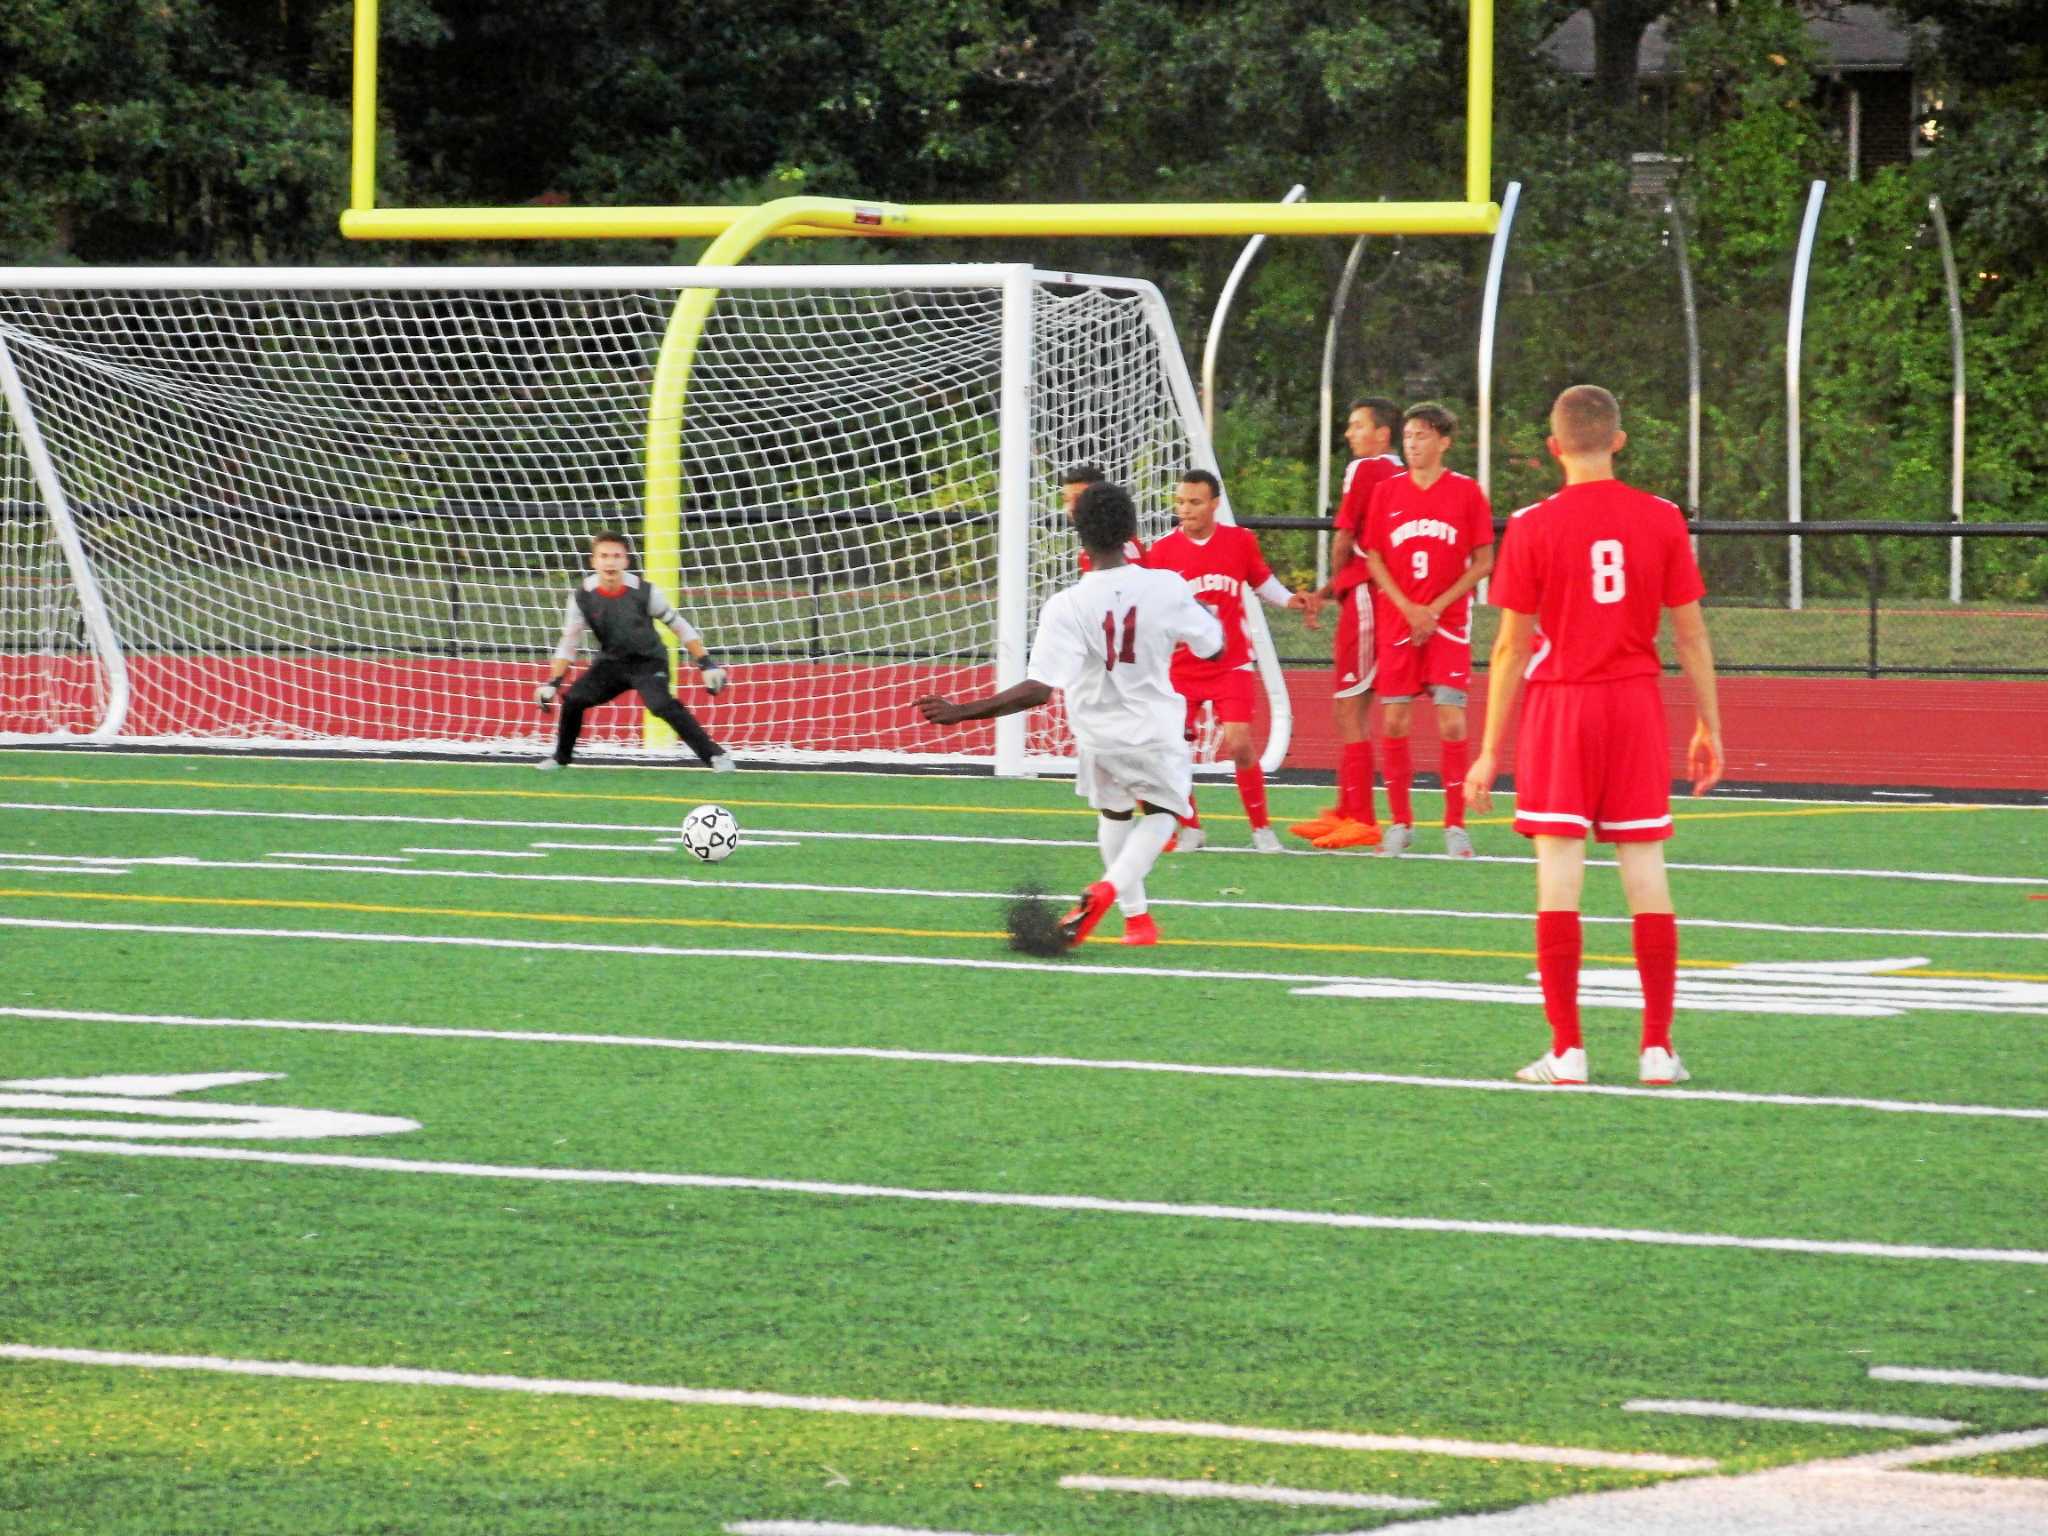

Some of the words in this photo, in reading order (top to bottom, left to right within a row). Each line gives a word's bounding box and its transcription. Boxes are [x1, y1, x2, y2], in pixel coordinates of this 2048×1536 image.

[1412, 550, 1428, 579] 9
[1590, 539, 1626, 604] 8
[1102, 605, 1136, 671] 11
